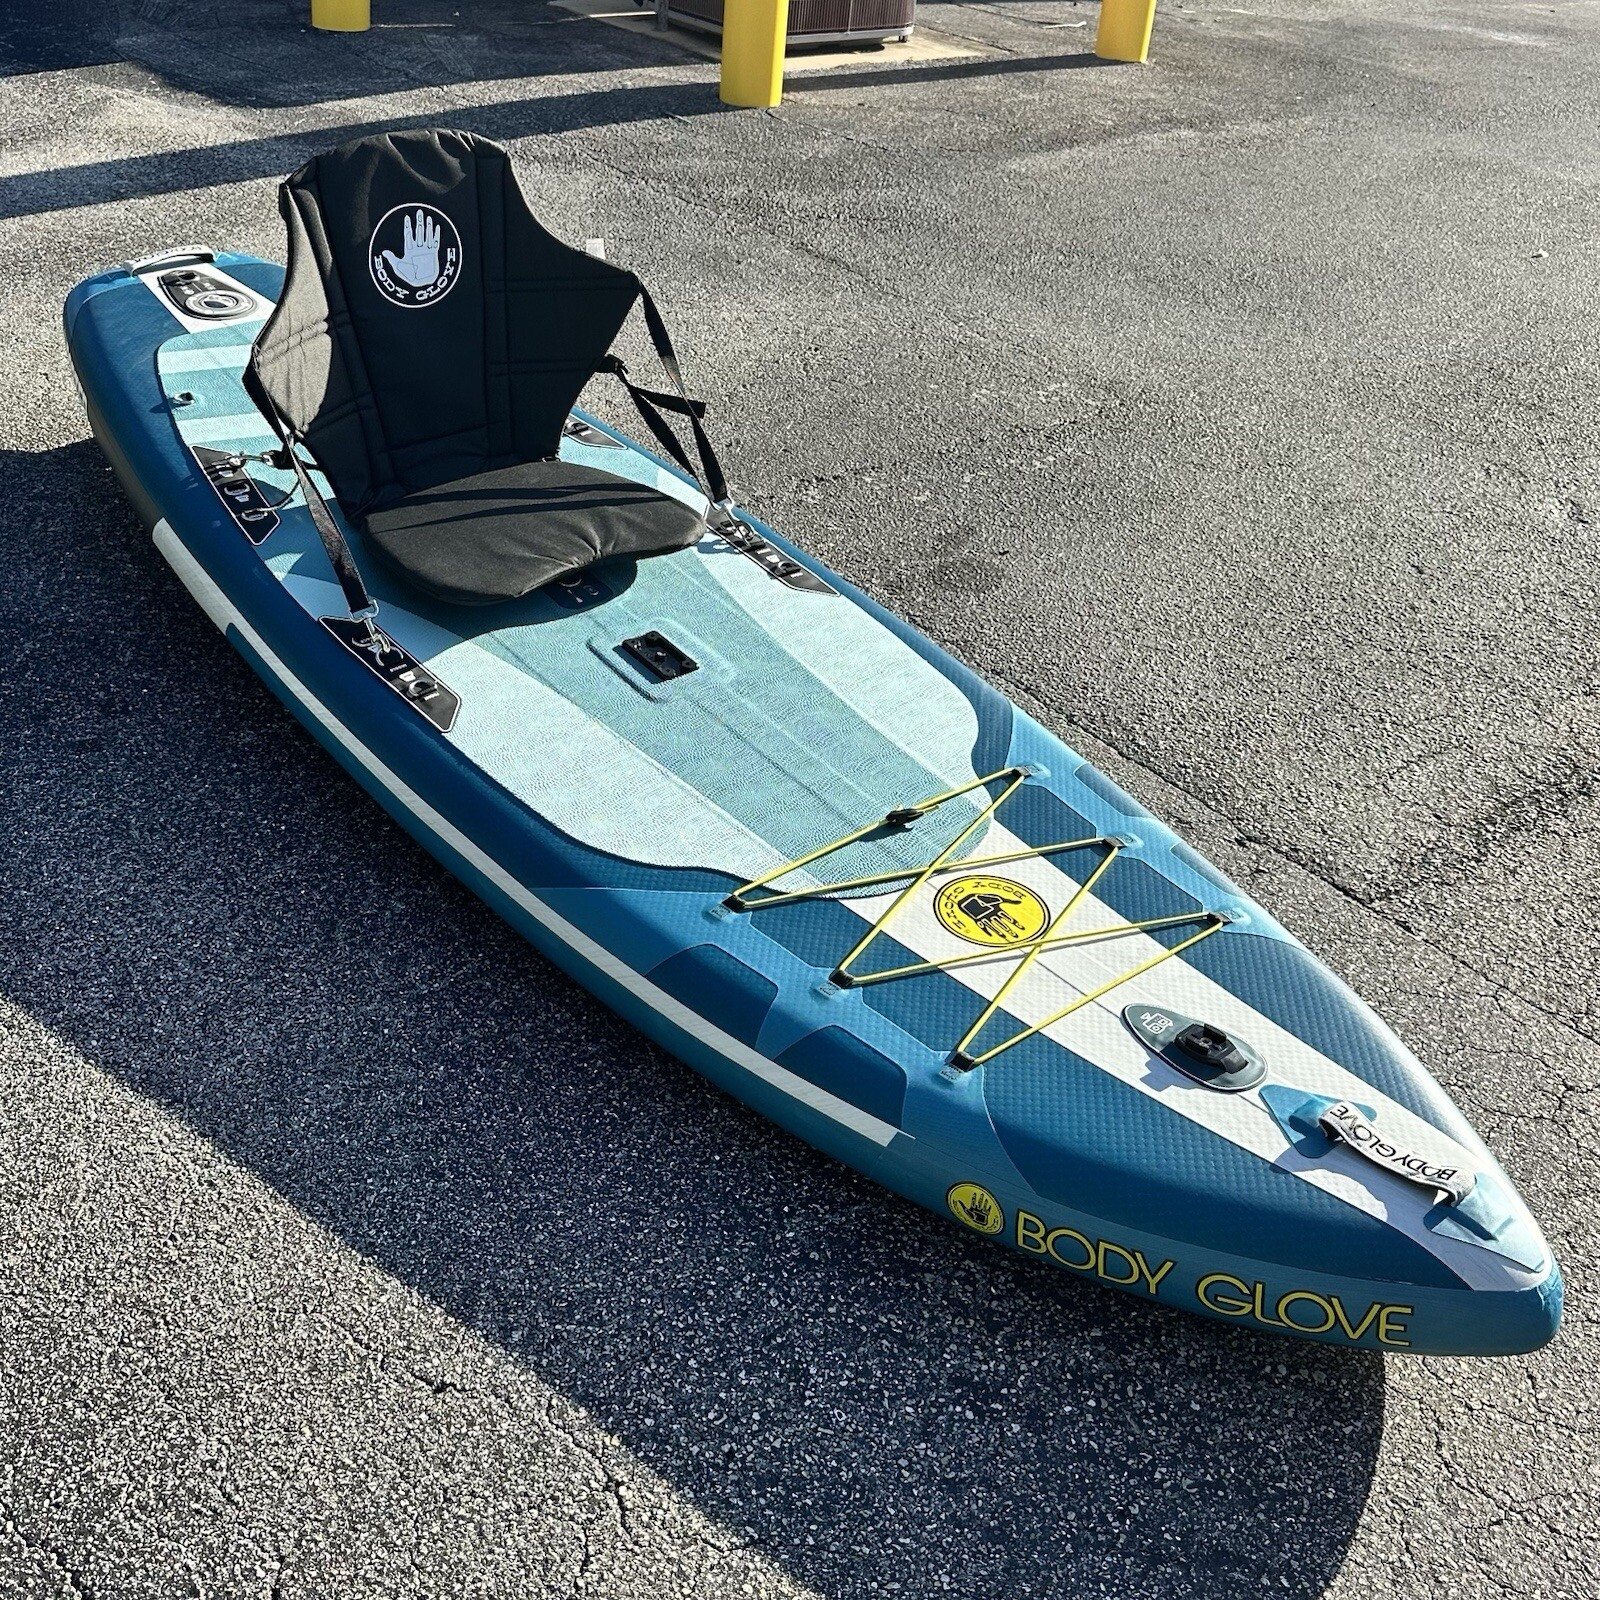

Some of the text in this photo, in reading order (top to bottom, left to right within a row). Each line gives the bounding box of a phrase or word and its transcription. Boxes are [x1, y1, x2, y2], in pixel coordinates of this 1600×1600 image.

[374, 247, 456, 301] BODY GLOVE
[944, 881, 1027, 930] BODY GLOVE
[1330, 1104, 1458, 1181] BODY GLOVE
[1016, 1209, 1175, 1294] BODY
[1196, 1273, 1413, 1346] GLOVE
